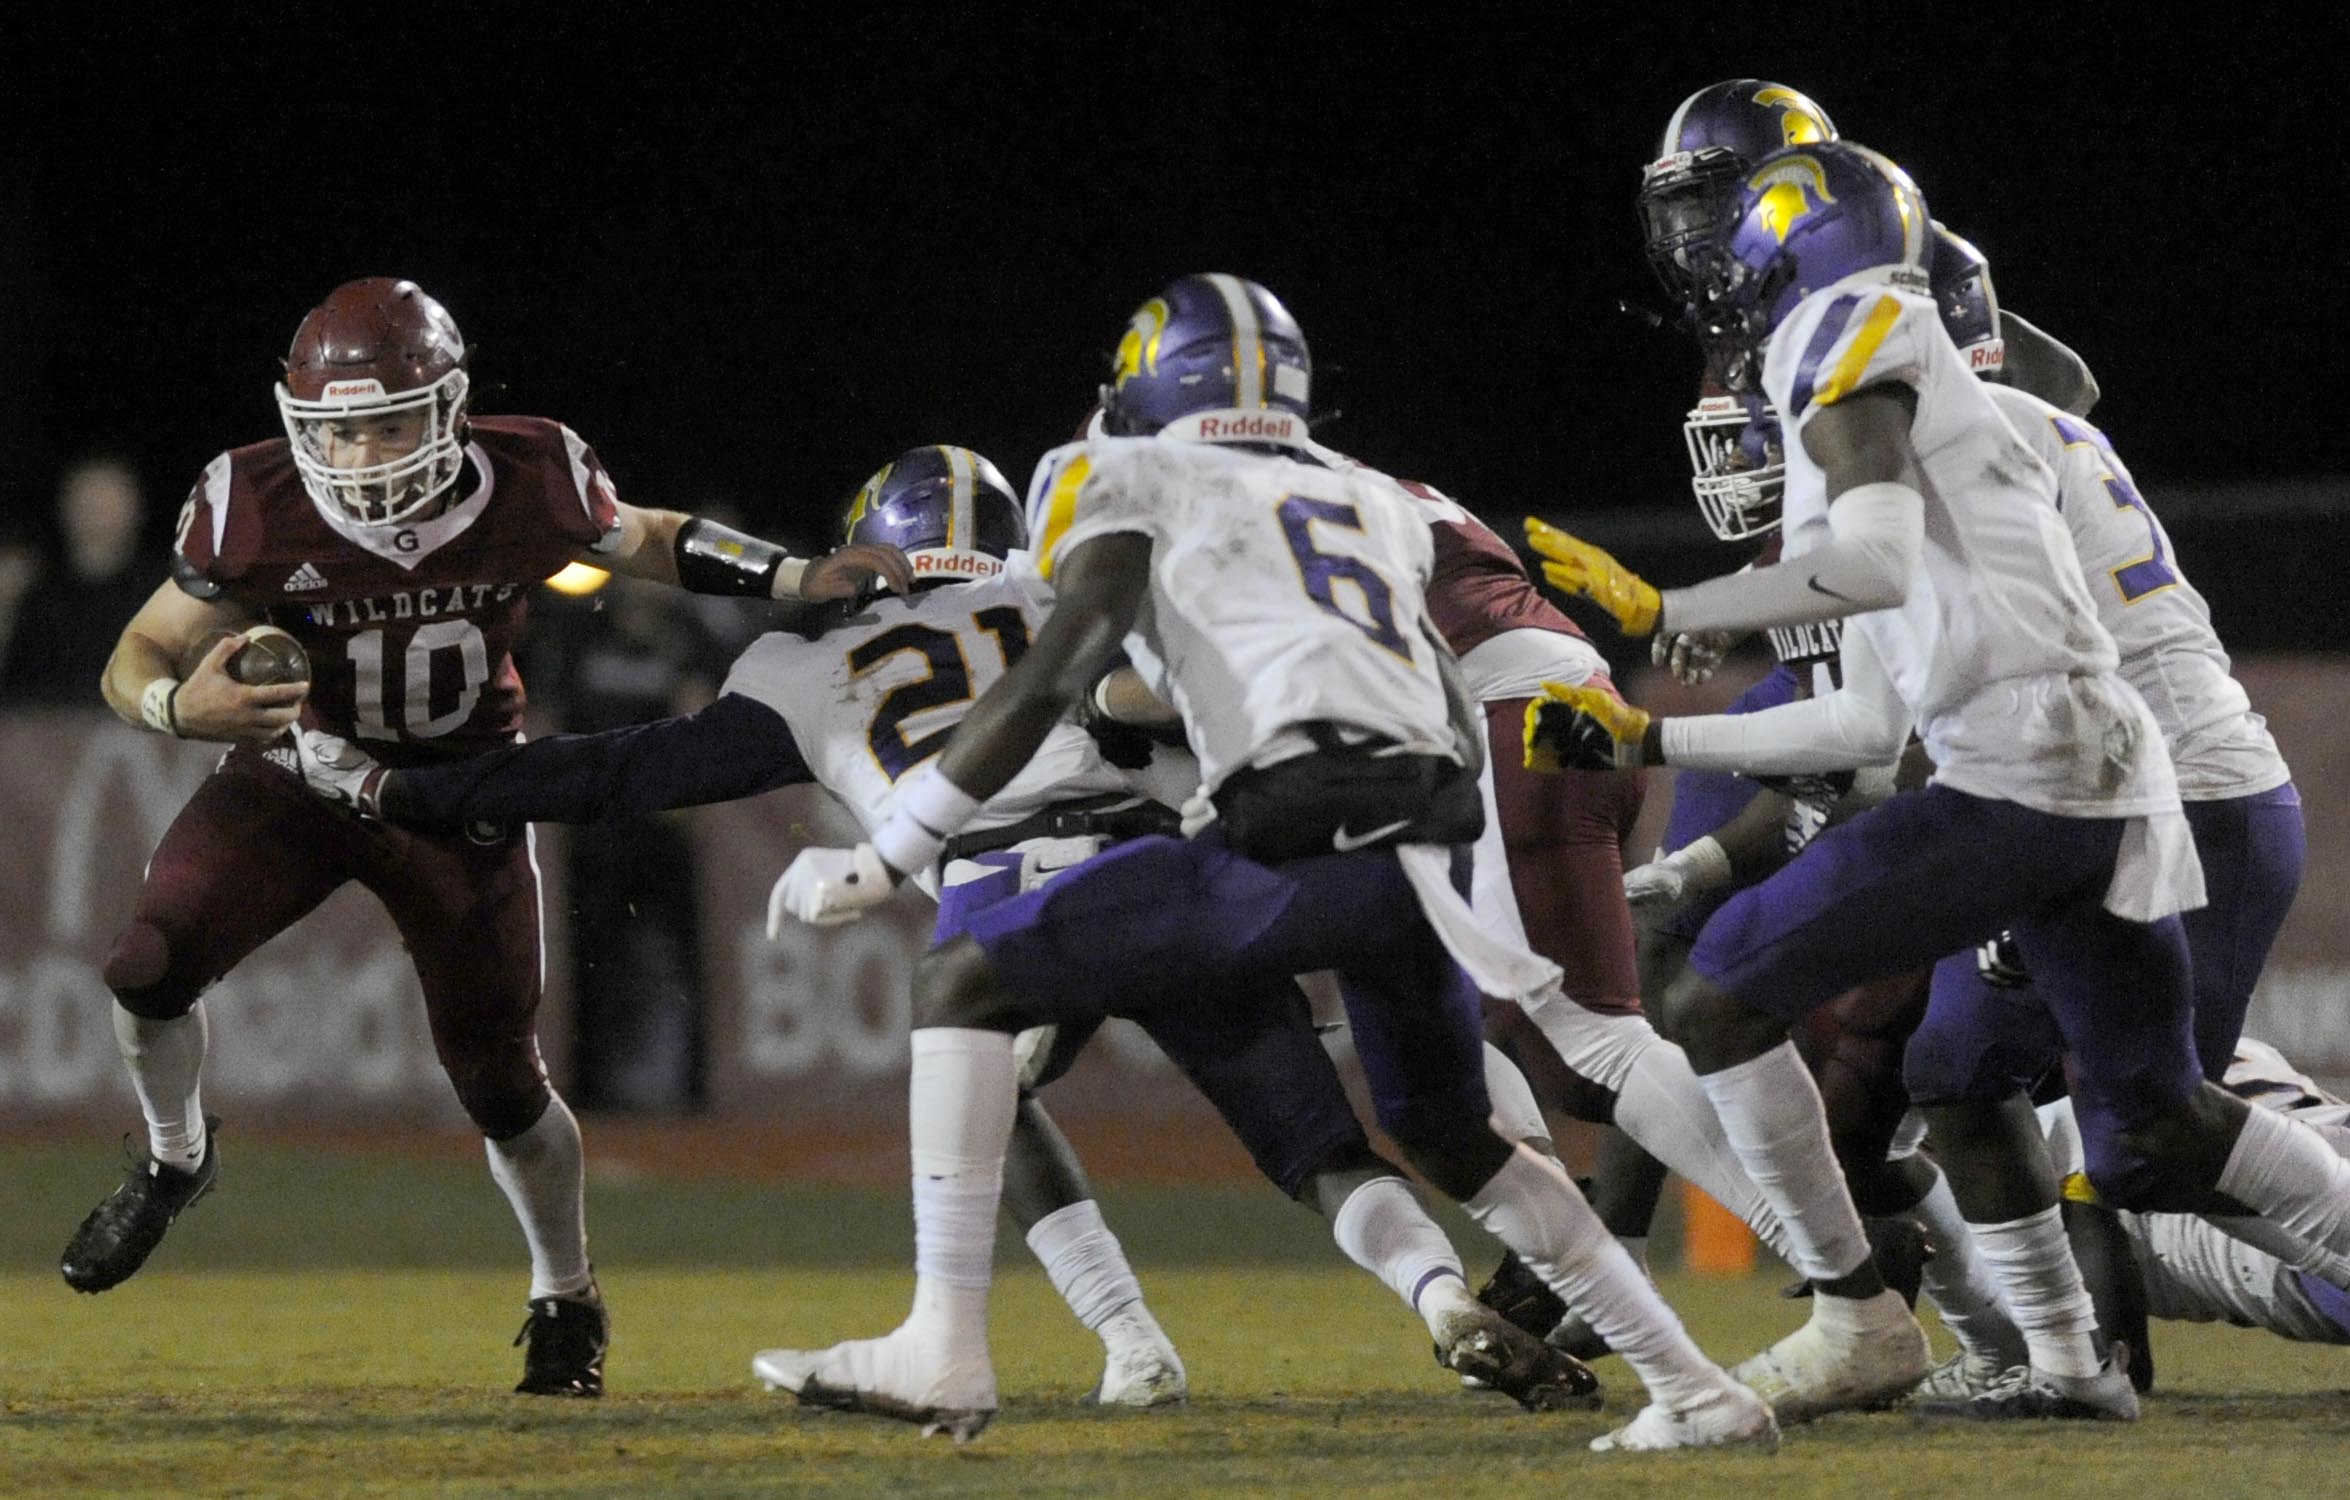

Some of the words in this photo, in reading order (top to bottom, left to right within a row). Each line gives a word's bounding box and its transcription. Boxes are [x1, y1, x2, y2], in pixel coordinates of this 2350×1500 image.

[1200, 416, 1292, 438] Riddell
[394, 529, 419, 552] G
[283, 577, 329, 592] adidas
[1275, 490, 1418, 672] 6
[346, 618, 489, 743] 10
